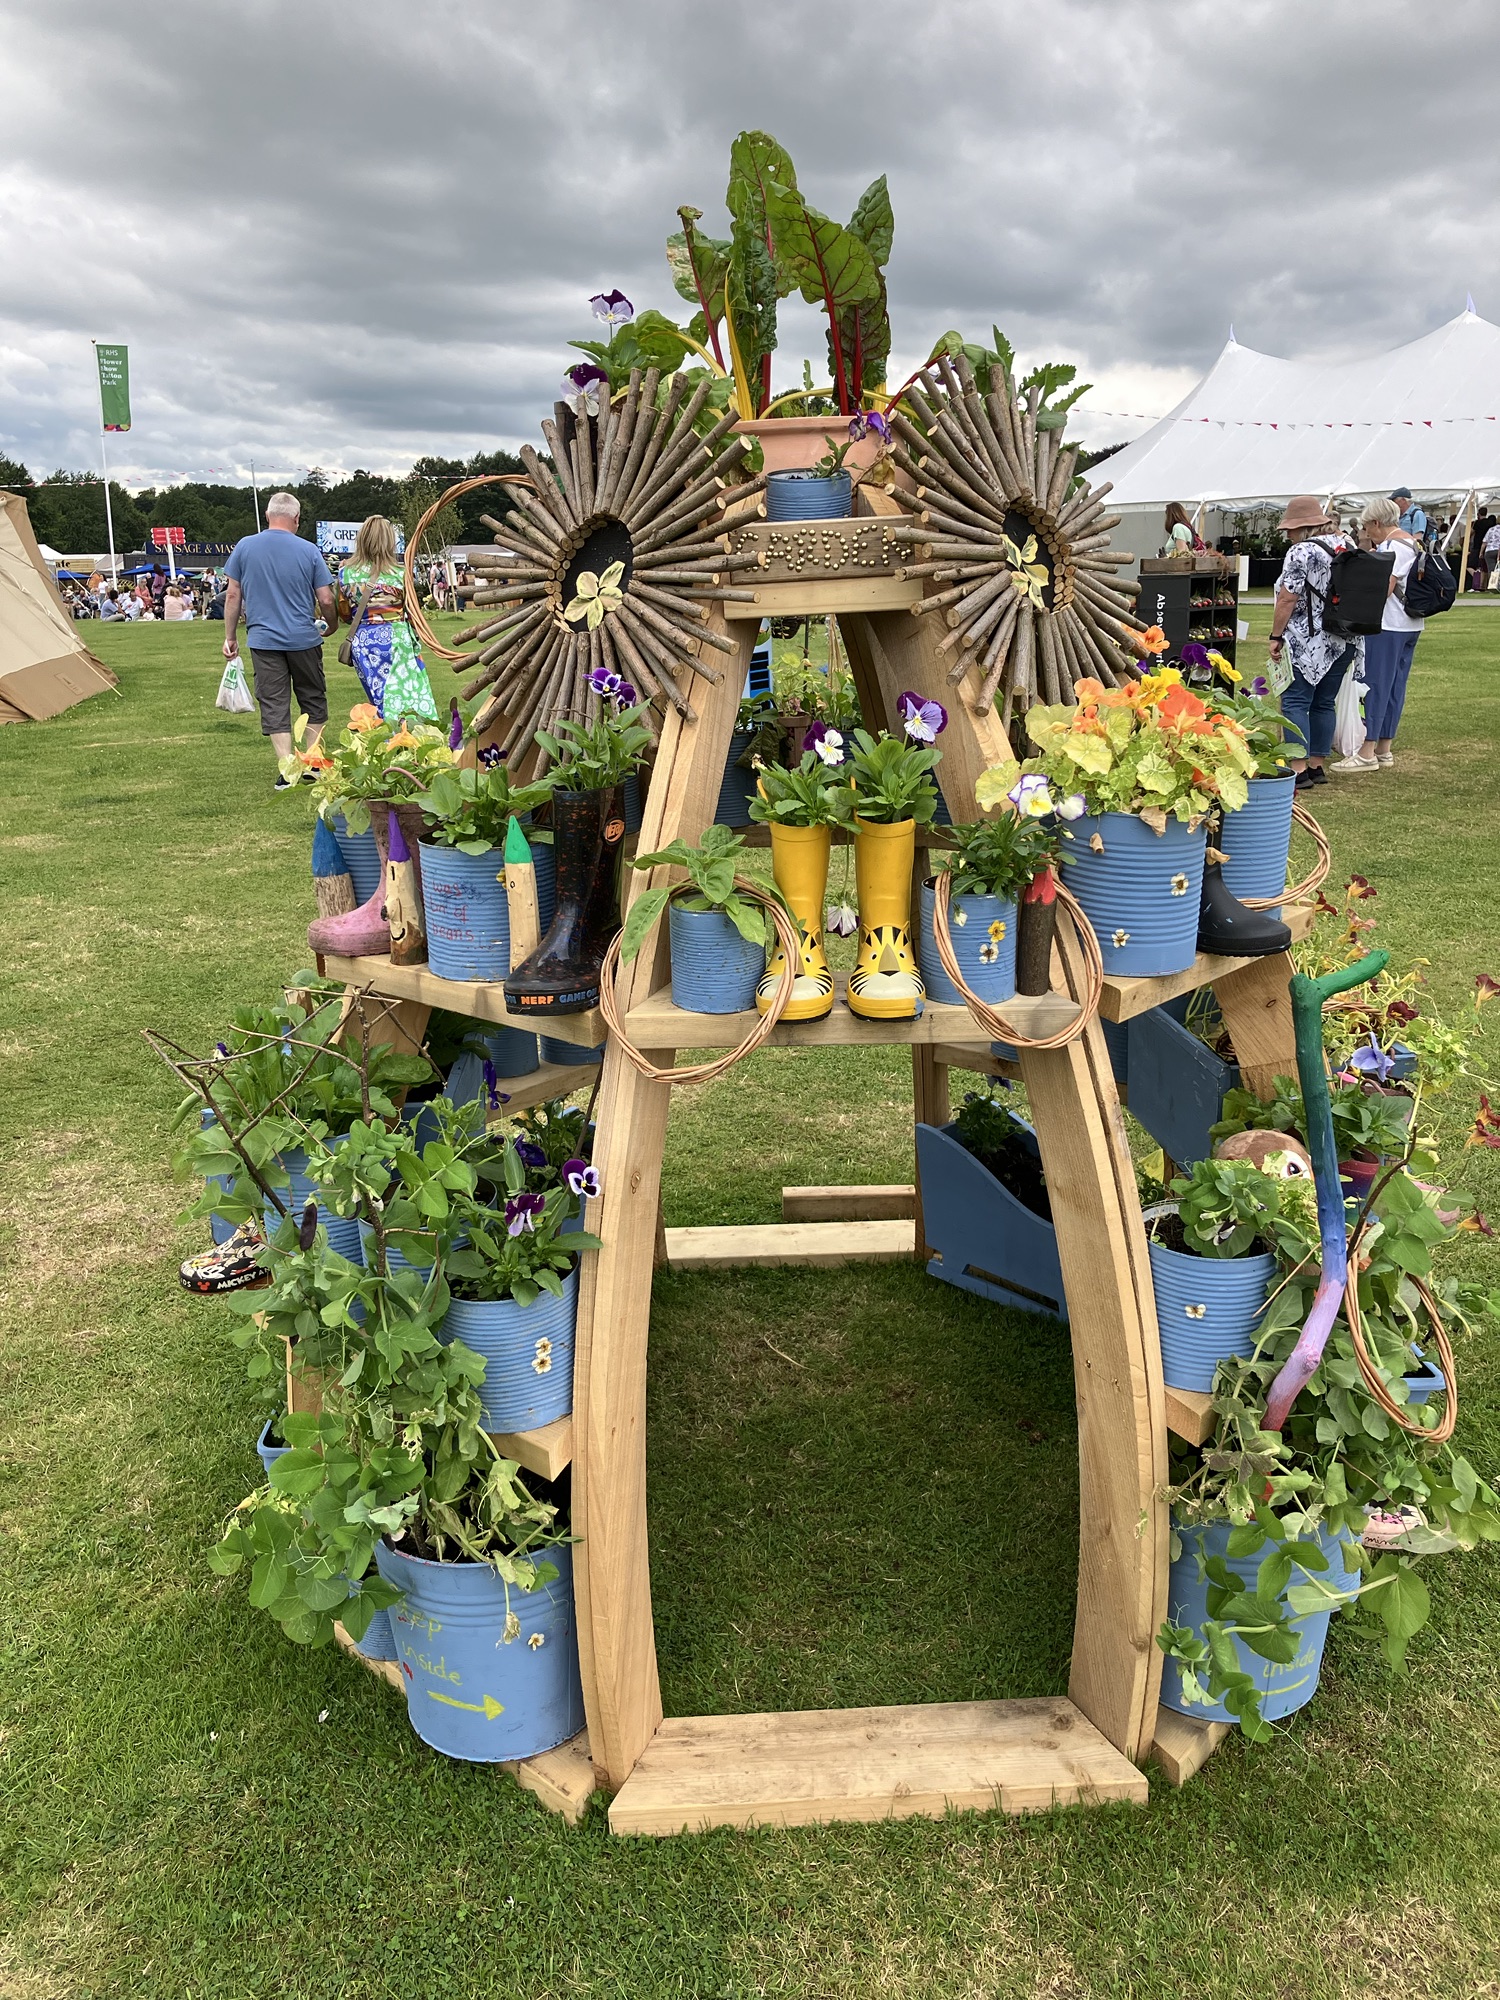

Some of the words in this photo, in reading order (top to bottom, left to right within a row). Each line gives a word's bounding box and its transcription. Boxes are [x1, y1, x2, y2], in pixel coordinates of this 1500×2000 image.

[155, 544, 202, 554] SASAGE
[204, 543, 212, 554] &
[734, 524, 912, 573] GARDEN
[453, 904, 470, 925] of
[520, 995, 554, 1005] NERF
[559, 992, 586, 1004] GAME
[216, 1271, 257, 1290] MICKEY
[401, 1640, 464, 1686] inside
